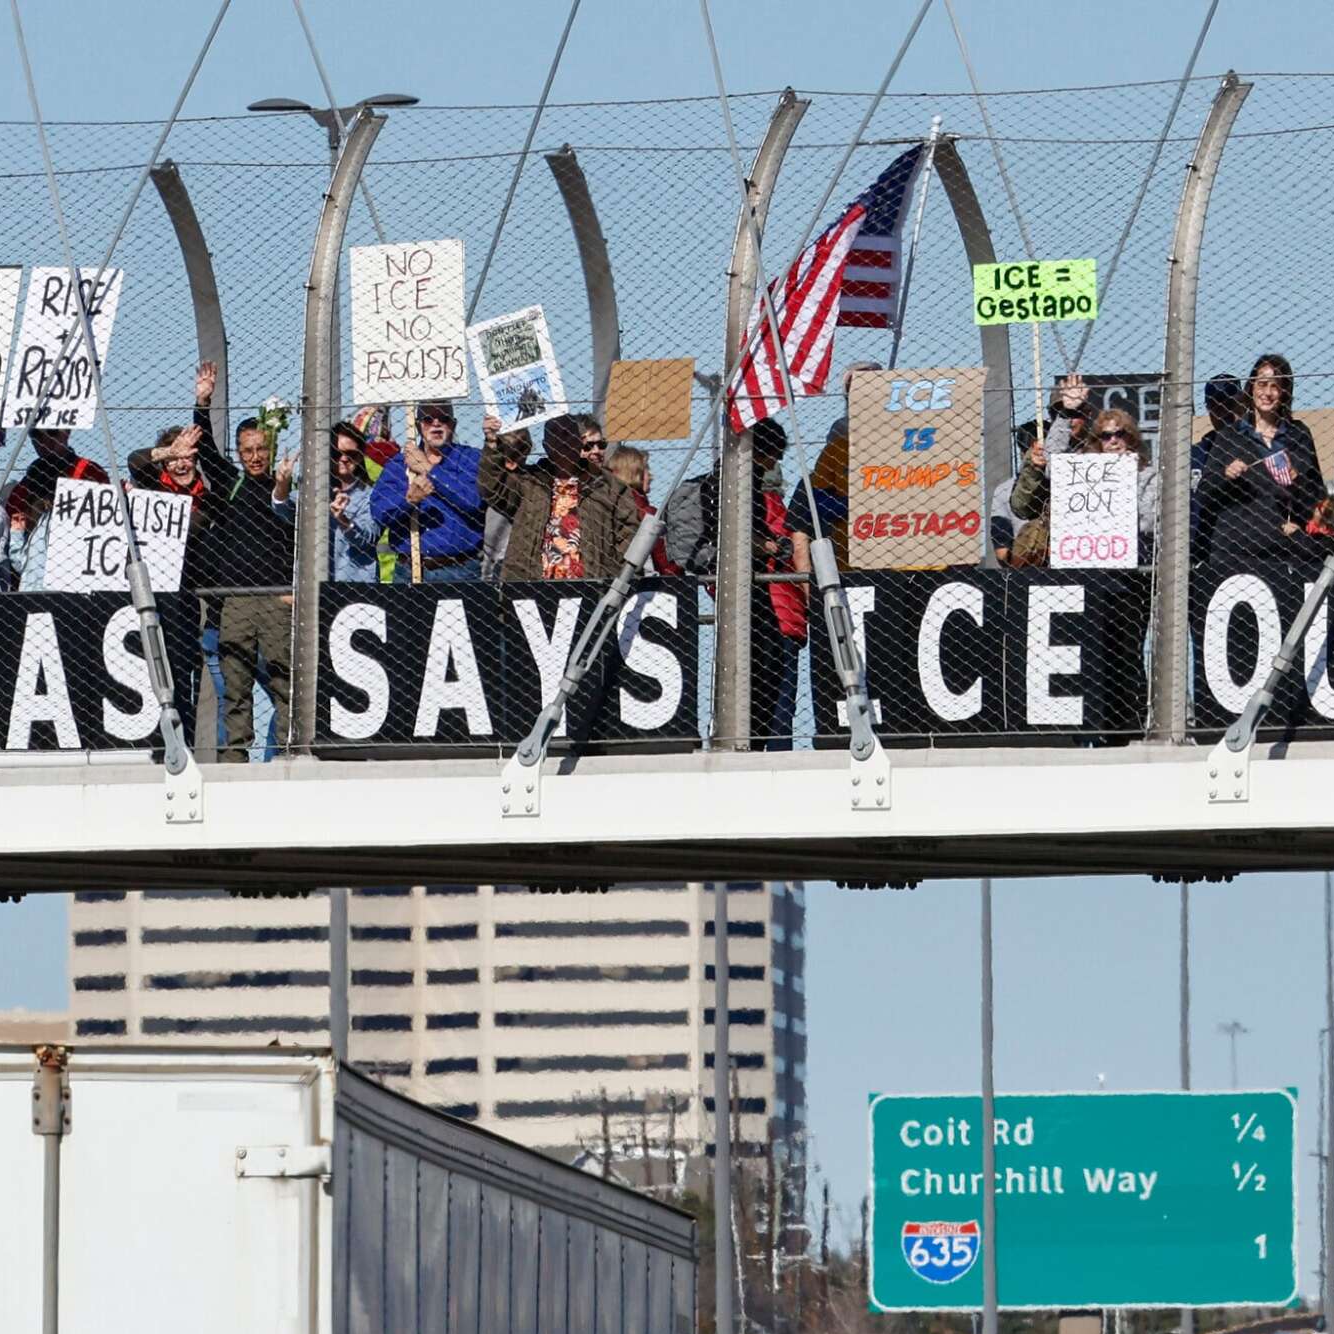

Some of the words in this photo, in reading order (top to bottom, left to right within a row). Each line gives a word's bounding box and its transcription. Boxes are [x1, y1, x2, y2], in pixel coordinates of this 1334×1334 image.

[386, 250, 433, 276] NO
[994, 265, 1042, 290] ICE
[40, 276, 105, 317] RISE
[373, 278, 438, 314] ICE
[977, 292, 1092, 319] Gestapo
[386, 315, 432, 342] NO
[366, 346, 464, 384] FASCISTS
[884, 377, 956, 412] ICE
[56, 408, 79, 427] ICE
[901, 427, 938, 452] IS
[860, 462, 977, 492] TRUMP'S
[1068, 460, 1119, 486] ICE
[56, 488, 185, 539] #ABOLISH
[853, 511, 981, 541] GESTAPO
[1059, 535, 1129, 561] GOOD
[329, 590, 683, 739] SAYS
[837, 582, 1085, 727] ICE
[900, 1117, 971, 1147] Coit
[992, 1117, 1035, 1146] Rd
[900, 1166, 1065, 1196] Churchill
[1083, 1167, 1158, 1200] Way
[910, 1236, 973, 1268] 635
[1254, 1233, 1267, 1259] 1
